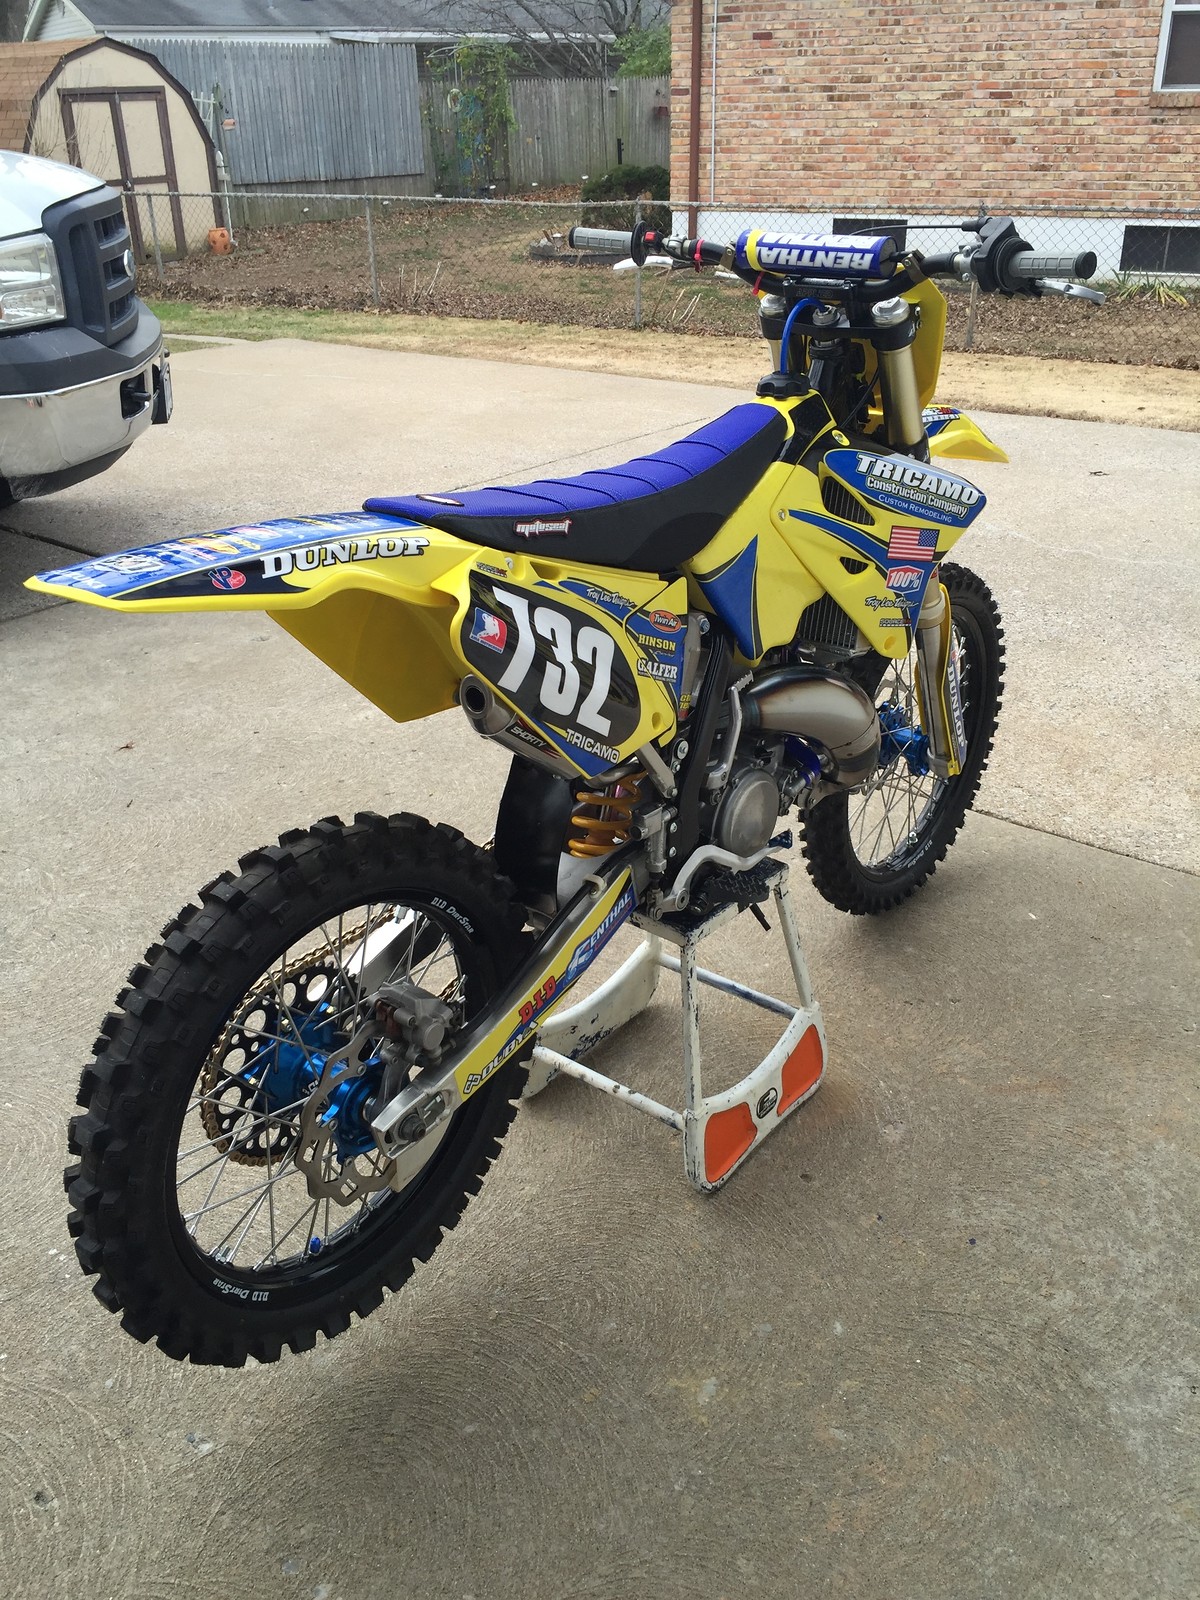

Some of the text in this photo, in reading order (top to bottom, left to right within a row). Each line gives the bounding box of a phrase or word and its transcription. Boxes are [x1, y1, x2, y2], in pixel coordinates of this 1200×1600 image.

[856, 453, 979, 506] TRICAMO
[866, 476, 968, 519] Construction Company
[259, 536, 430, 580] DUNLOP
[888, 571, 922, 588] 100%
[492, 585, 616, 738] 732
[638, 634, 677, 652] HINSON
[637, 658, 678, 680] GALFER
[510, 726, 546, 747] SHORTY
[566, 728, 621, 765] TRICAMO
